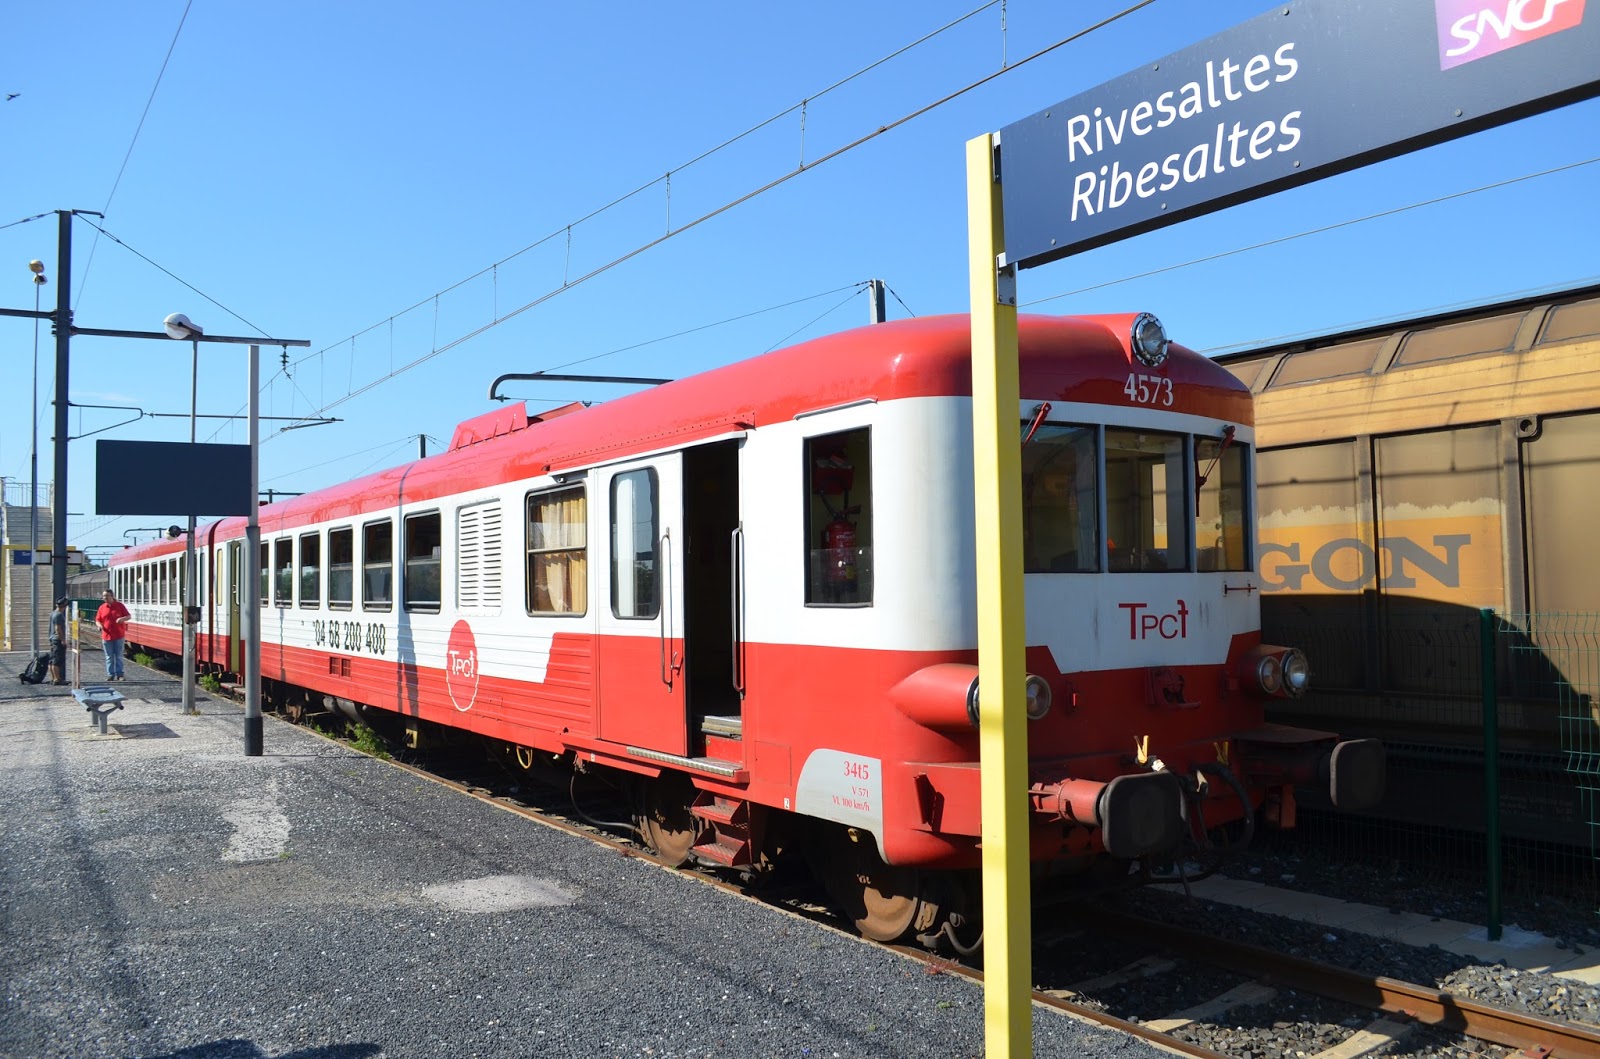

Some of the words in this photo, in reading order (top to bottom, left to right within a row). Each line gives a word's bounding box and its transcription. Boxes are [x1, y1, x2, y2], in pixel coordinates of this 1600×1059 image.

[1066, 42, 1299, 163] Rivesaltes
[1070, 110, 1302, 222] Ribesaltes
[1124, 373, 1174, 406] 4573
[315, 619, 326, 647] 04
[329, 619, 340, 649] 68
[344, 621, 362, 652] 200
[365, 622, 386, 656] 400
[843, 760, 869, 781] 34t5
[842, 797, 853, 809] 100
[853, 799, 870, 812] km/h
